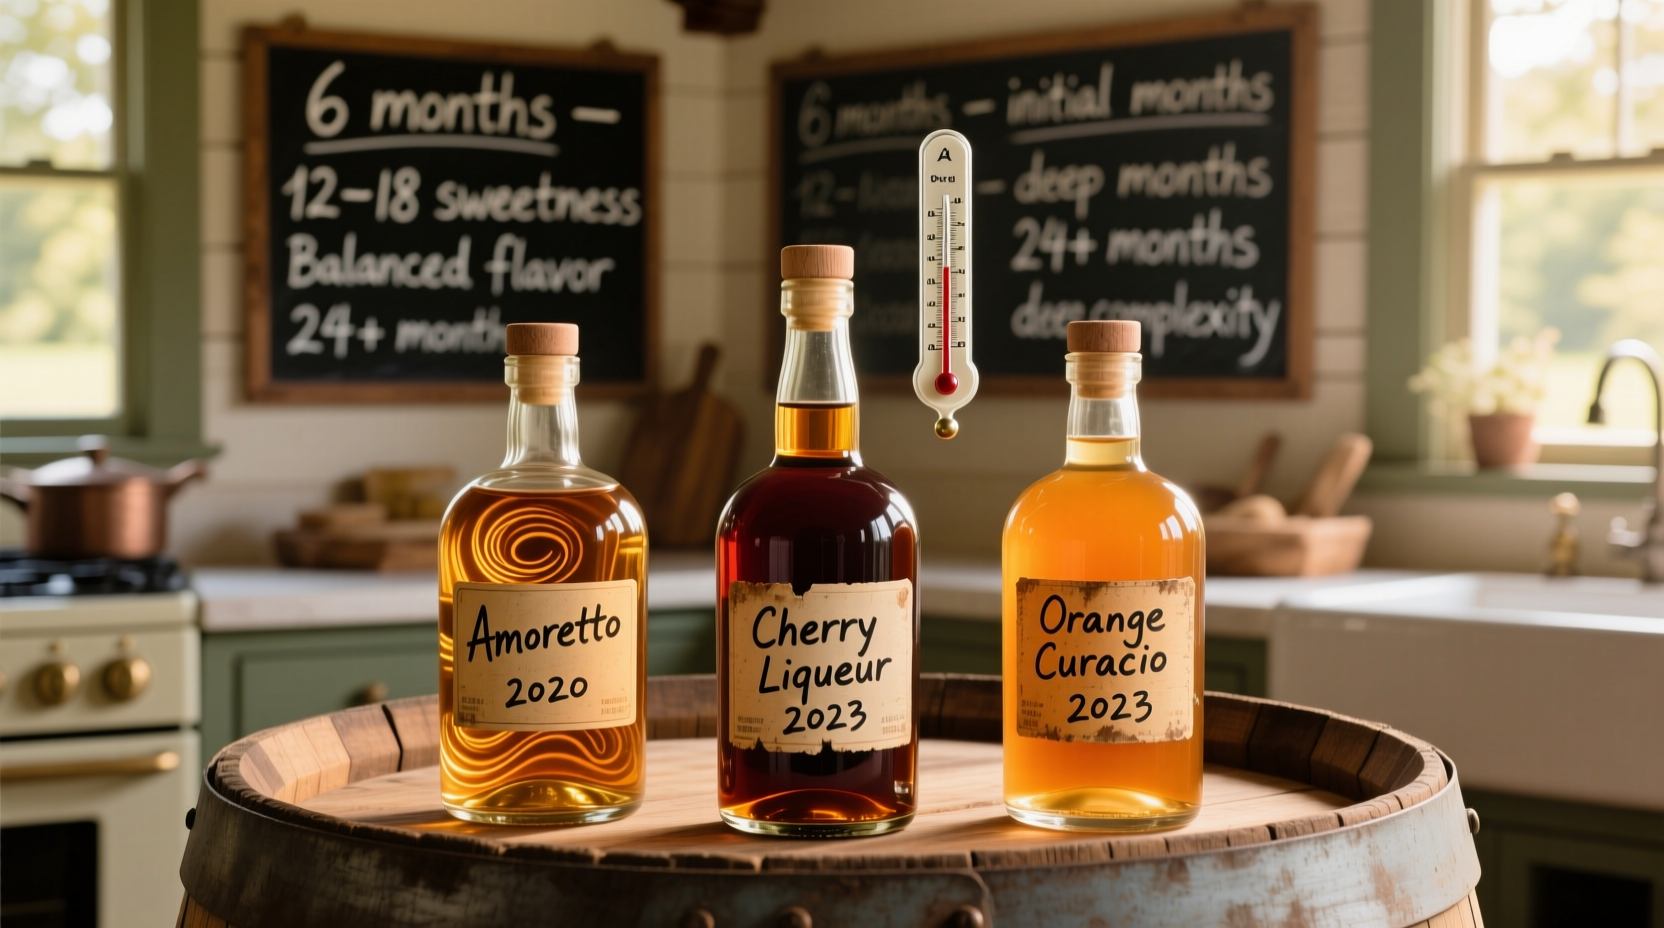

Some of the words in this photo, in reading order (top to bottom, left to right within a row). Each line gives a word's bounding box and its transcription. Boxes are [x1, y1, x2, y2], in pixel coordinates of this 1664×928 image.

[305, 61, 349, 138] 6
[370, 71, 557, 140] months
[797, 80, 832, 149] 6
[1006, 60, 1114, 126] initial
[1129, 58, 1275, 116] months
[433, 171, 642, 226] sweetness
[1013, 149, 1105, 221] deep
[1116, 141, 1273, 198] months
[287, 231, 473, 289] Balanced
[483, 232, 616, 297] flavor
[1009, 216, 1098, 273] 24+
[1106, 207, 1260, 269] months
[286, 302, 385, 359] 24+
[467, 604, 620, 662] Amoretto
[752, 605, 877, 657] Cherry
[1040, 594, 1165, 648] Orange
[759, 655, 892, 705] Liqueur
[1035, 642, 1167, 680] Curacio
[505, 676, 588, 708] 2020
[783, 700, 866, 735] 2023
[1067, 690, 1152, 723] 2023
